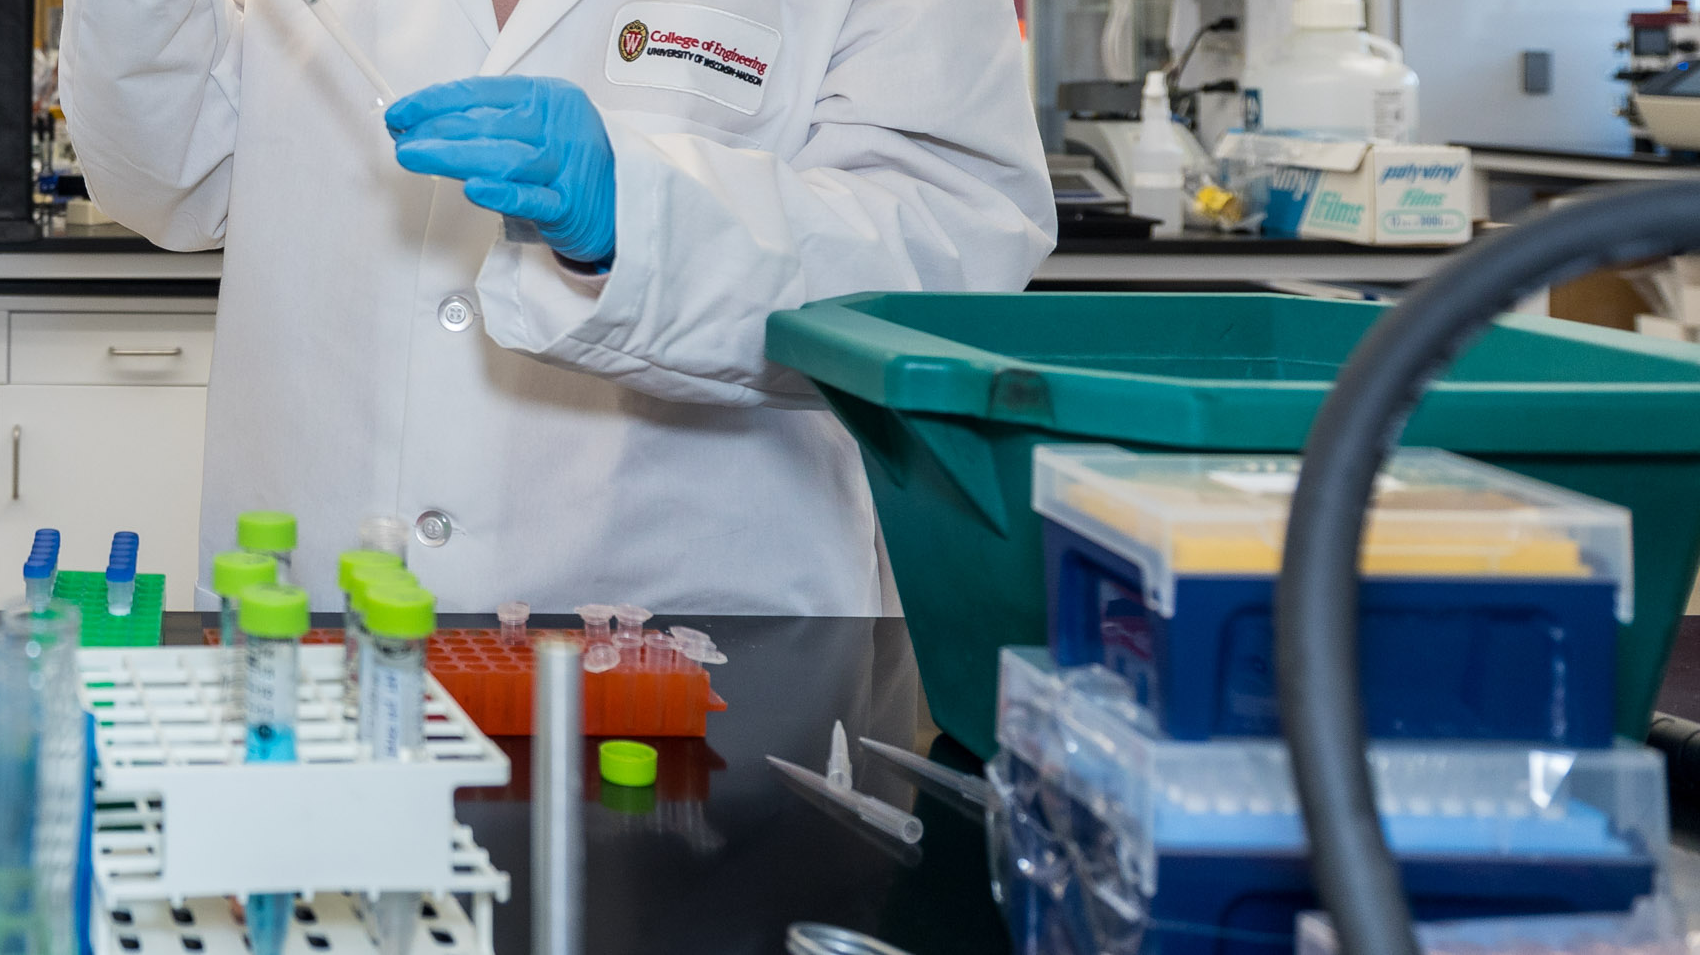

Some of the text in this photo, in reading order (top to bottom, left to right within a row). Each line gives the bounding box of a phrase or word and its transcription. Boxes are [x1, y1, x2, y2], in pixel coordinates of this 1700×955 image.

[646, 47, 694, 61] UNIVERSITY
[694, 54, 705, 64] OF
[650, 30, 768, 76] College of Engineering
